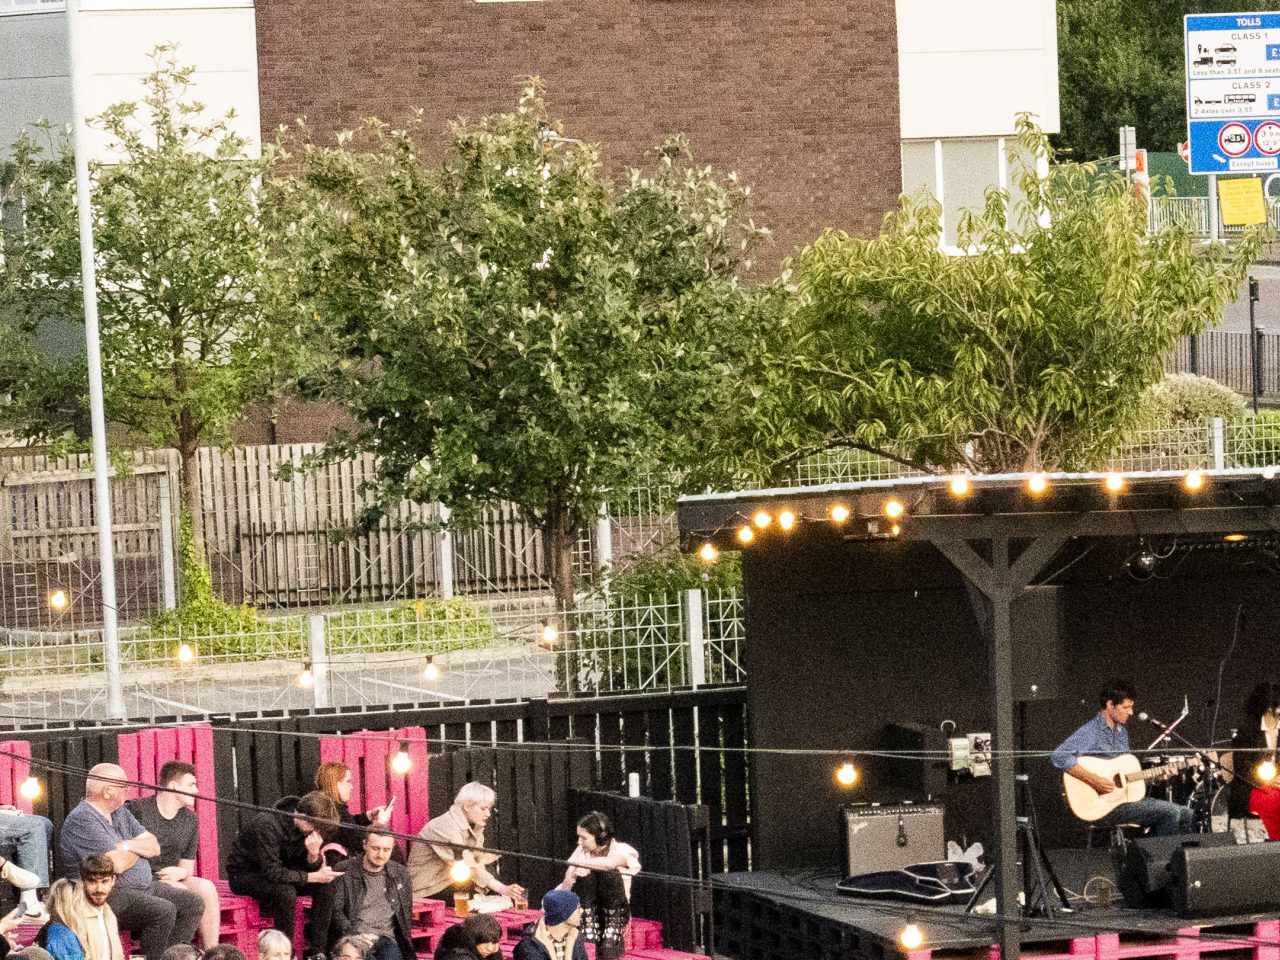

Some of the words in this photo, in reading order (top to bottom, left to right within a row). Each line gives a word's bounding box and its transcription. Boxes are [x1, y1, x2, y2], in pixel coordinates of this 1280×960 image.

[1236, 18, 1262, 27] TOLLS
[1231, 33, 1261, 41] CLASS
[1264, 32, 1269, 40] 1
[1209, 68, 1225, 76] than
[1243, 67, 1256, 75] and
[1231, 82, 1262, 90] CLASS
[1265, 81, 1271, 89] 2
